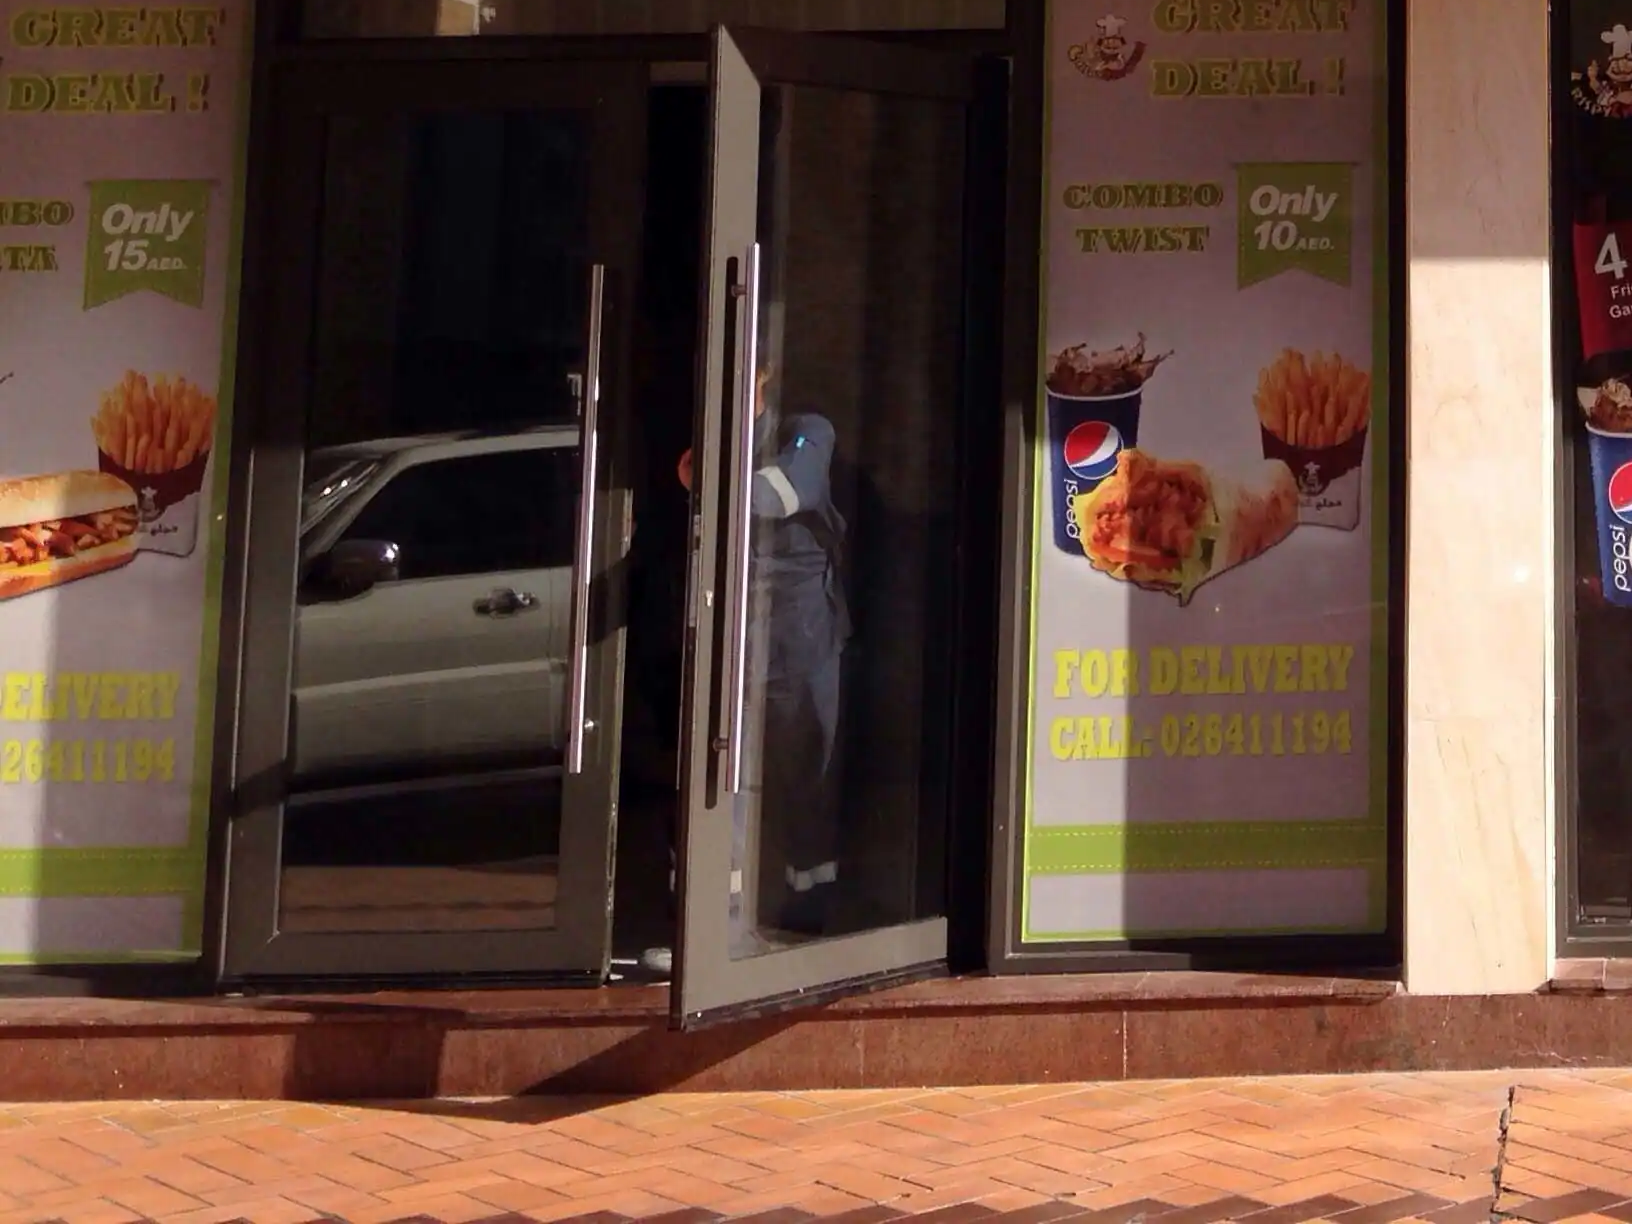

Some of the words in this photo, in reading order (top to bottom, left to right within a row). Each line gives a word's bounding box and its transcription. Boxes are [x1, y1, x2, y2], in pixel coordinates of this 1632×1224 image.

[10, 7, 226, 48] GREAT
[0, 200, 74, 227] BO
[1062, 182, 1223, 210] COMBO
[1249, 185, 1338, 222] Only
[102, 203, 194, 242] Only
[1075, 225, 1210, 253] TWIST
[1254, 220, 1298, 251] 10
[105, 239, 149, 271] 15
[1594, 232, 1628, 279] 4
[1610, 524, 1632, 592] pepsi
[1052, 648, 1140, 698] FOR
[1150, 644, 1354, 695] DELIVERY
[0, 671, 179, 720] ELIVERY
[1160, 709, 1352, 757] 026411194
[0, 738, 175, 784] 26411194
